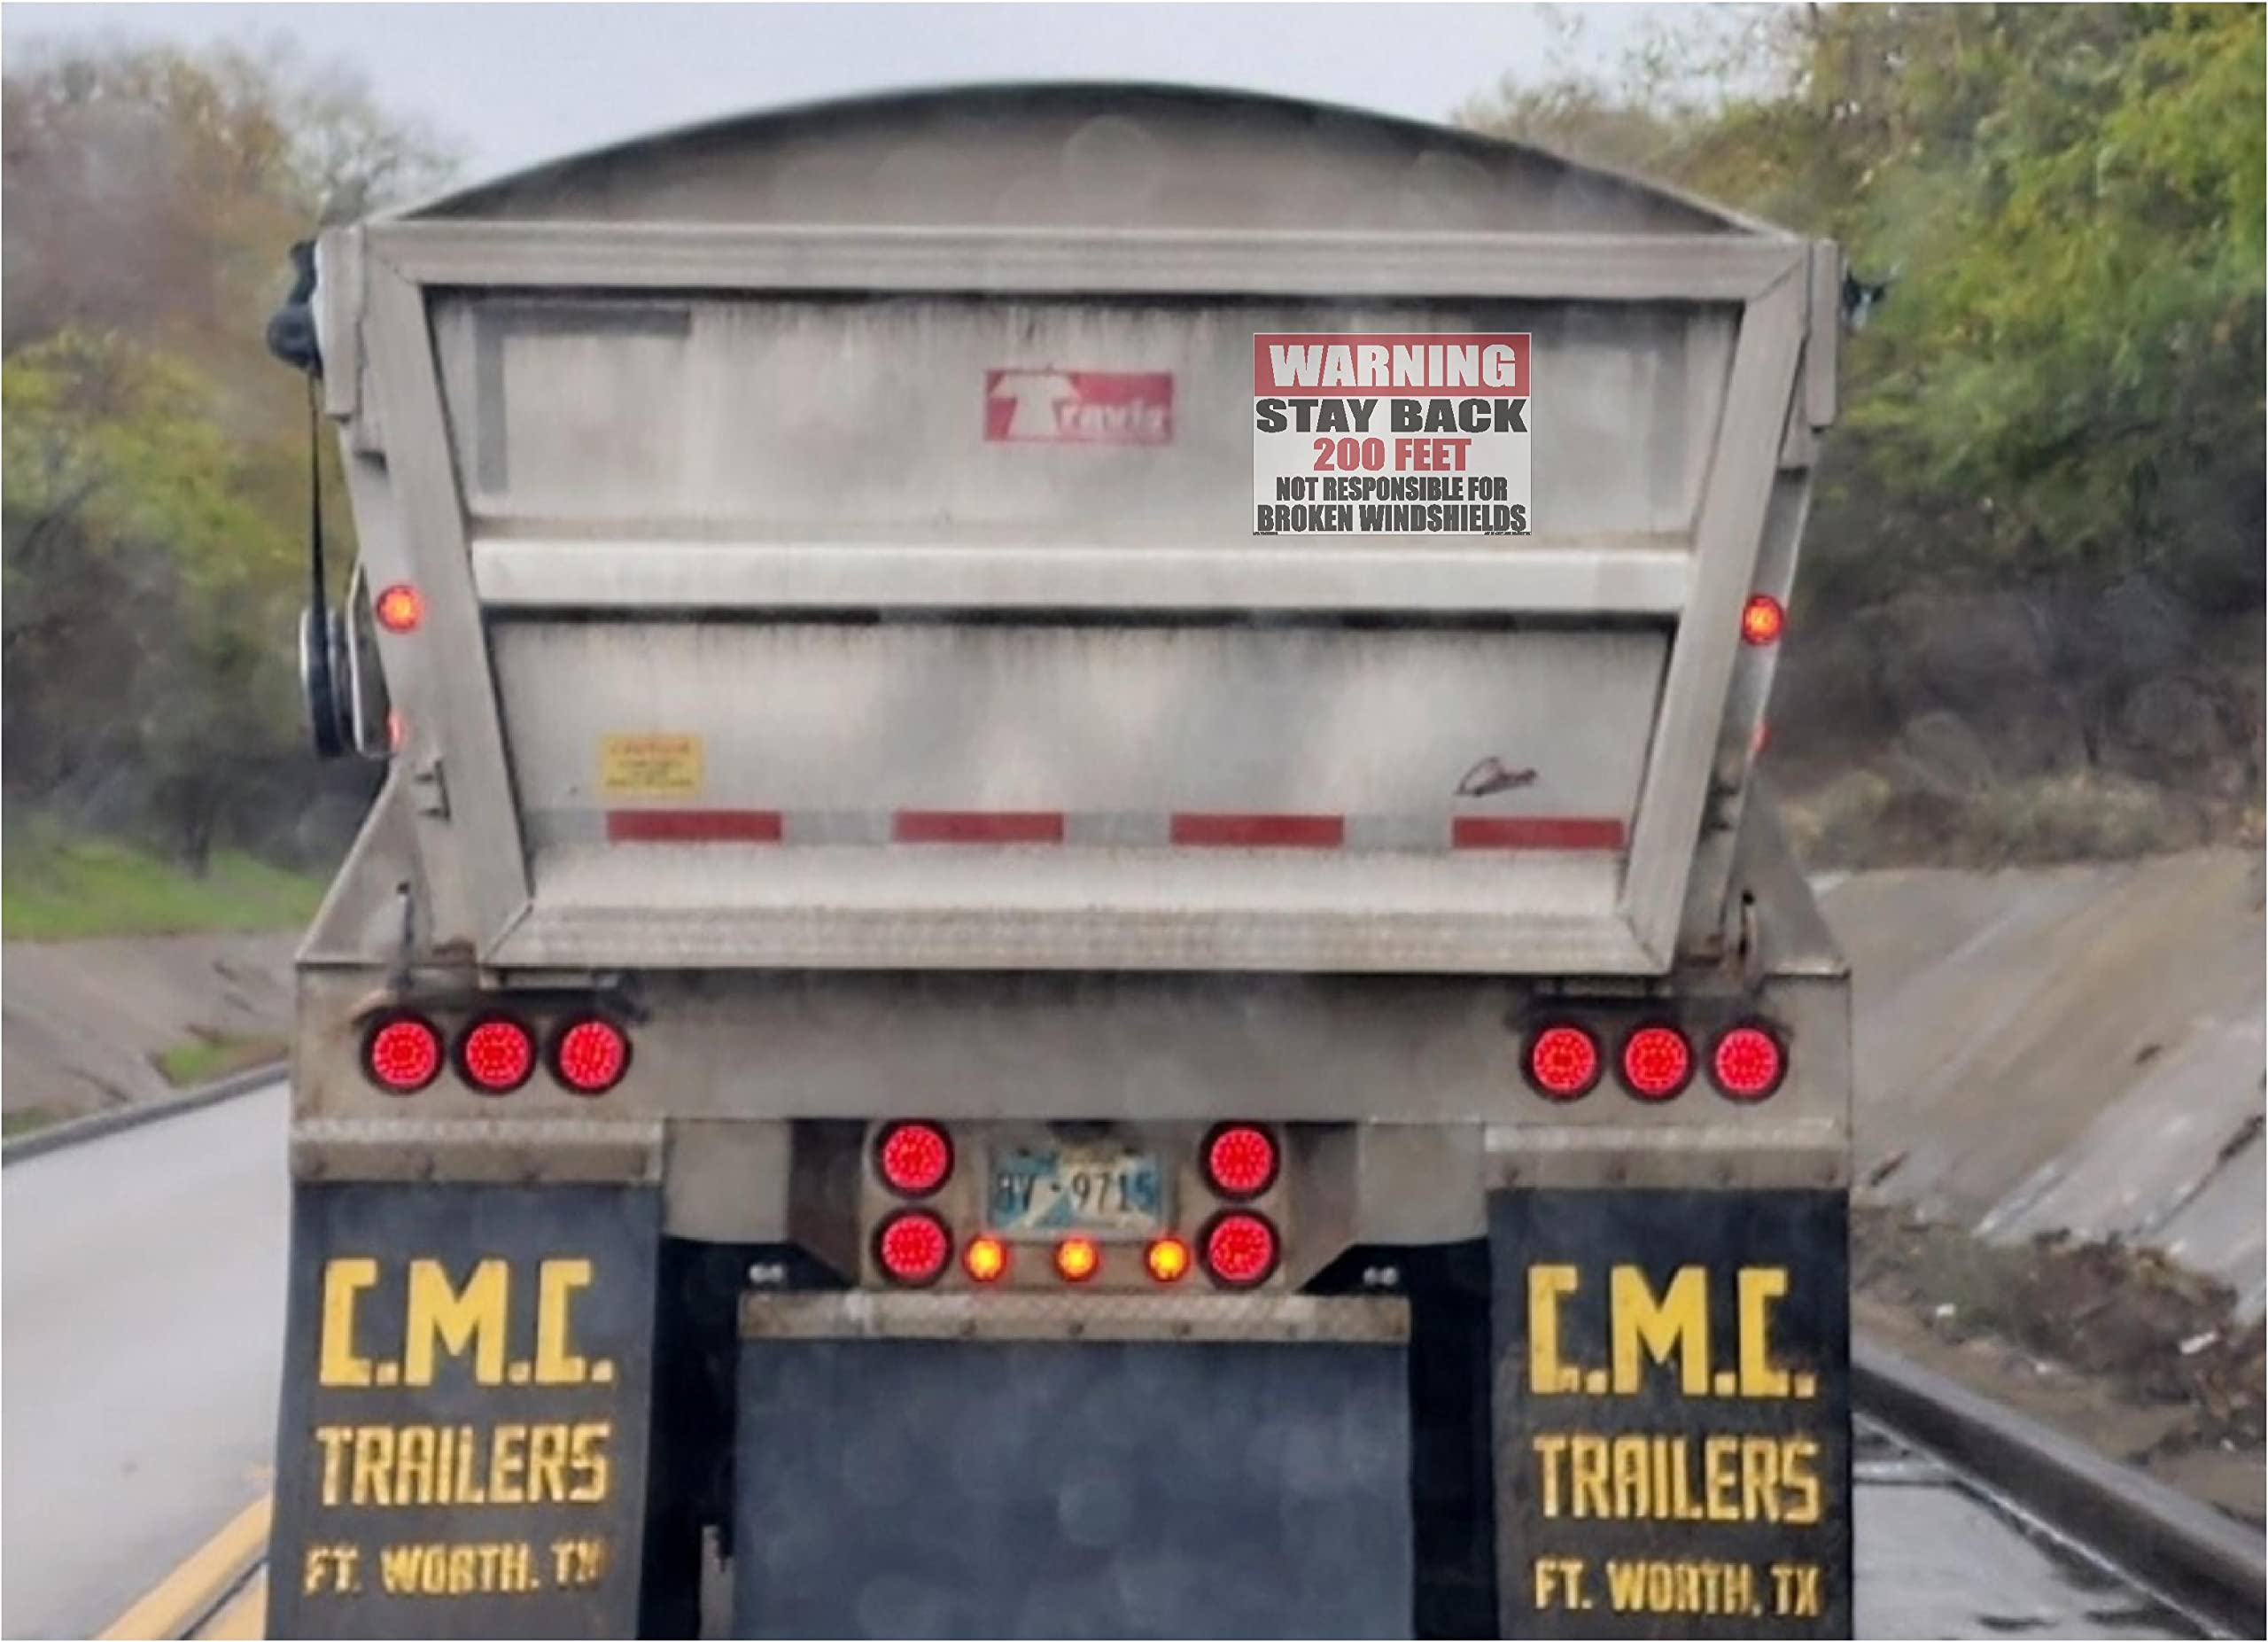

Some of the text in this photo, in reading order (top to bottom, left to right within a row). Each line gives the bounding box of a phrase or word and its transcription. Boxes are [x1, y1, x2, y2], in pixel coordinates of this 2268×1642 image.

[1269, 344, 1517, 388] WARNING
[1255, 398, 1528, 433] STAY BACK
[1313, 437, 1472, 471] 200 FEET
[1276, 476, 1509, 502] NOT RESPONSIBLE FOR
[1257, 503, 1527, 532] BROKEN WINDSHIELDS
[320, 1258, 614, 1387] C.M.C.
[1527, 1264, 1816, 1398] C.M.C.
[315, 1423, 611, 1506] TRAILERS
[1532, 1433, 1821, 1524] TRAILERS
[1534, 1557, 1594, 1611] FT.
[1772, 1563, 1820, 1617] TX
